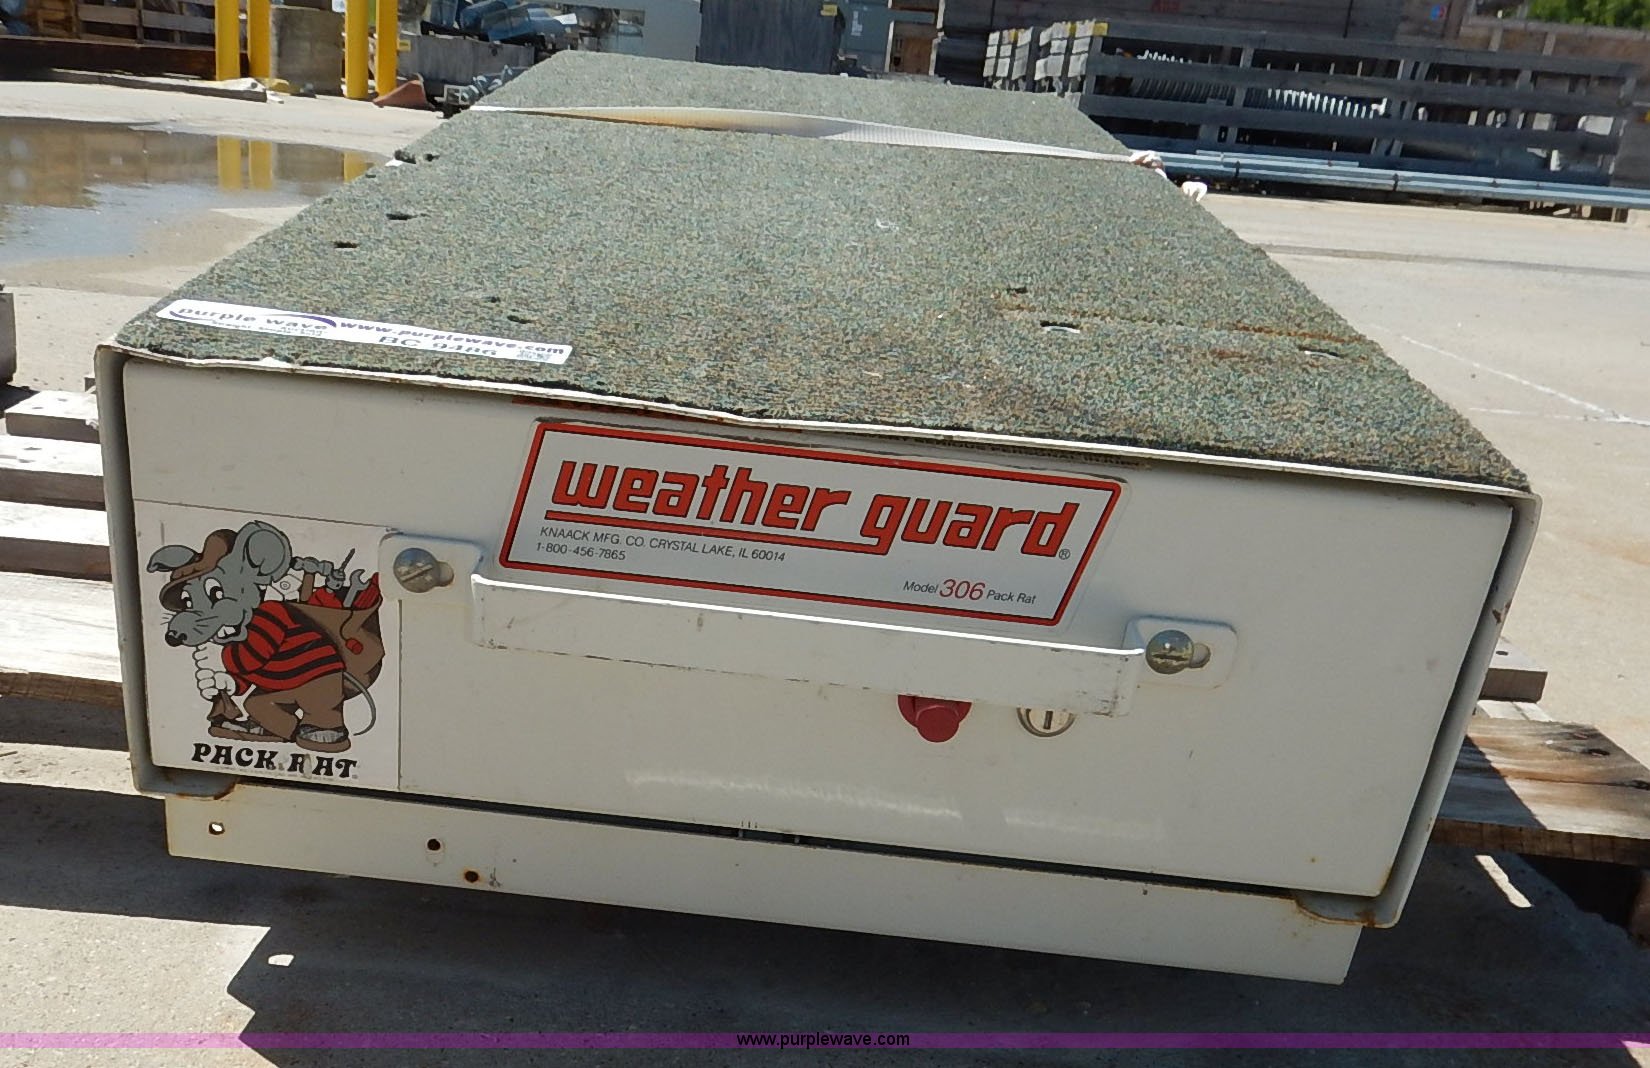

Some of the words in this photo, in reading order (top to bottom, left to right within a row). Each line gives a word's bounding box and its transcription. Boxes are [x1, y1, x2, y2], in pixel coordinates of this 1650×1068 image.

[178, 307, 257, 323] purple
[266, 318, 328, 331] wave
[340, 321, 565, 355] www.purplewave.com
[378, 336, 421, 348] BC
[551, 460, 852, 532] weather
[859, 493, 1081, 556] guard
[536, 542, 626, 561] 1-800-456-7865
[540, 526, 591, 541] KNAACK
[592, 532, 622, 545] MFG.
[625, 535, 646, 548] CO.
[649, 537, 699, 553] CRYSTAL
[701, 543, 735, 558] LAKE,
[738, 547, 749, 559] IL
[751, 548, 786, 562] 60014
[902, 580, 939, 594] Model
[939, 578, 986, 601] 306
[986, 589, 1014, 602] Pack
[1016, 592, 1037, 605] Rat
[191, 743, 279, 770] PACK
[287, 753, 358, 779] RAT
